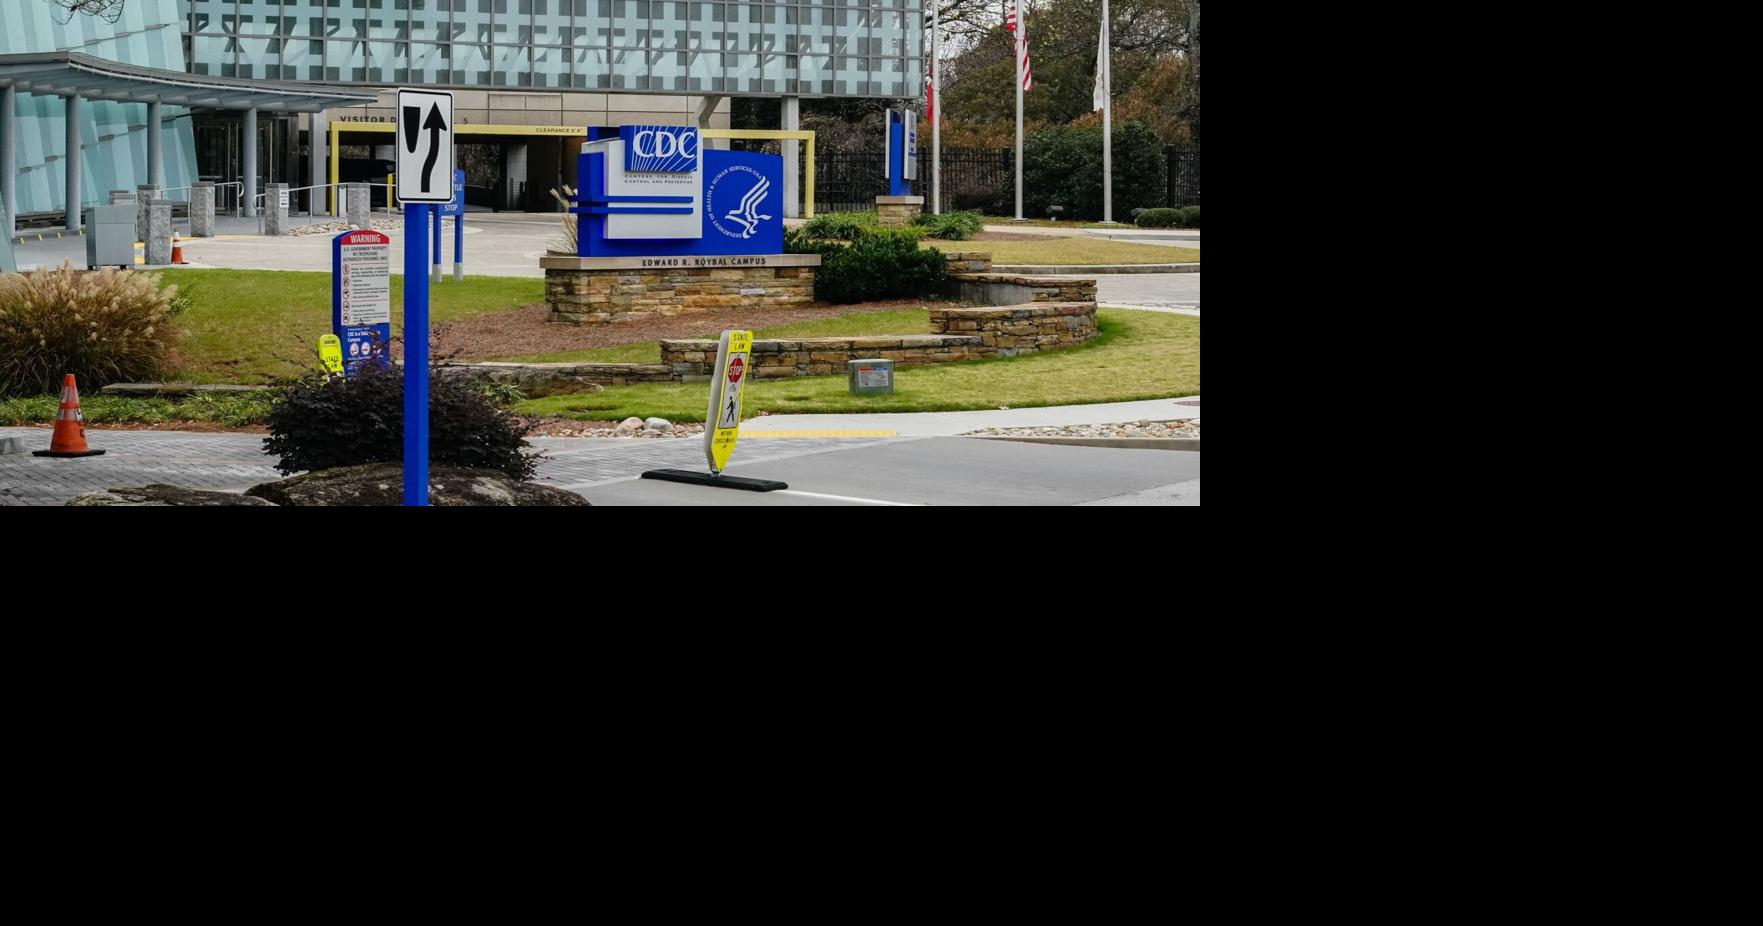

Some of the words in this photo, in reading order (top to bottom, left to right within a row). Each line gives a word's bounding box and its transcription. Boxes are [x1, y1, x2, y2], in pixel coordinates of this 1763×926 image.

[633, 130, 695, 158] CDC
[712, 168, 729, 185] HUMAN
[444, 204, 458, 212] STOP
[351, 234, 381, 244] WARNING
[642, 259, 679, 267] EDWARD
[682, 258, 691, 266] R.
[694, 258, 728, 266] ROYBAL
[732, 257, 767, 265] CAMPUS
[733, 333, 749, 341] STATE
[734, 342, 746, 350] LAW
[729, 365, 743, 376] STOP
